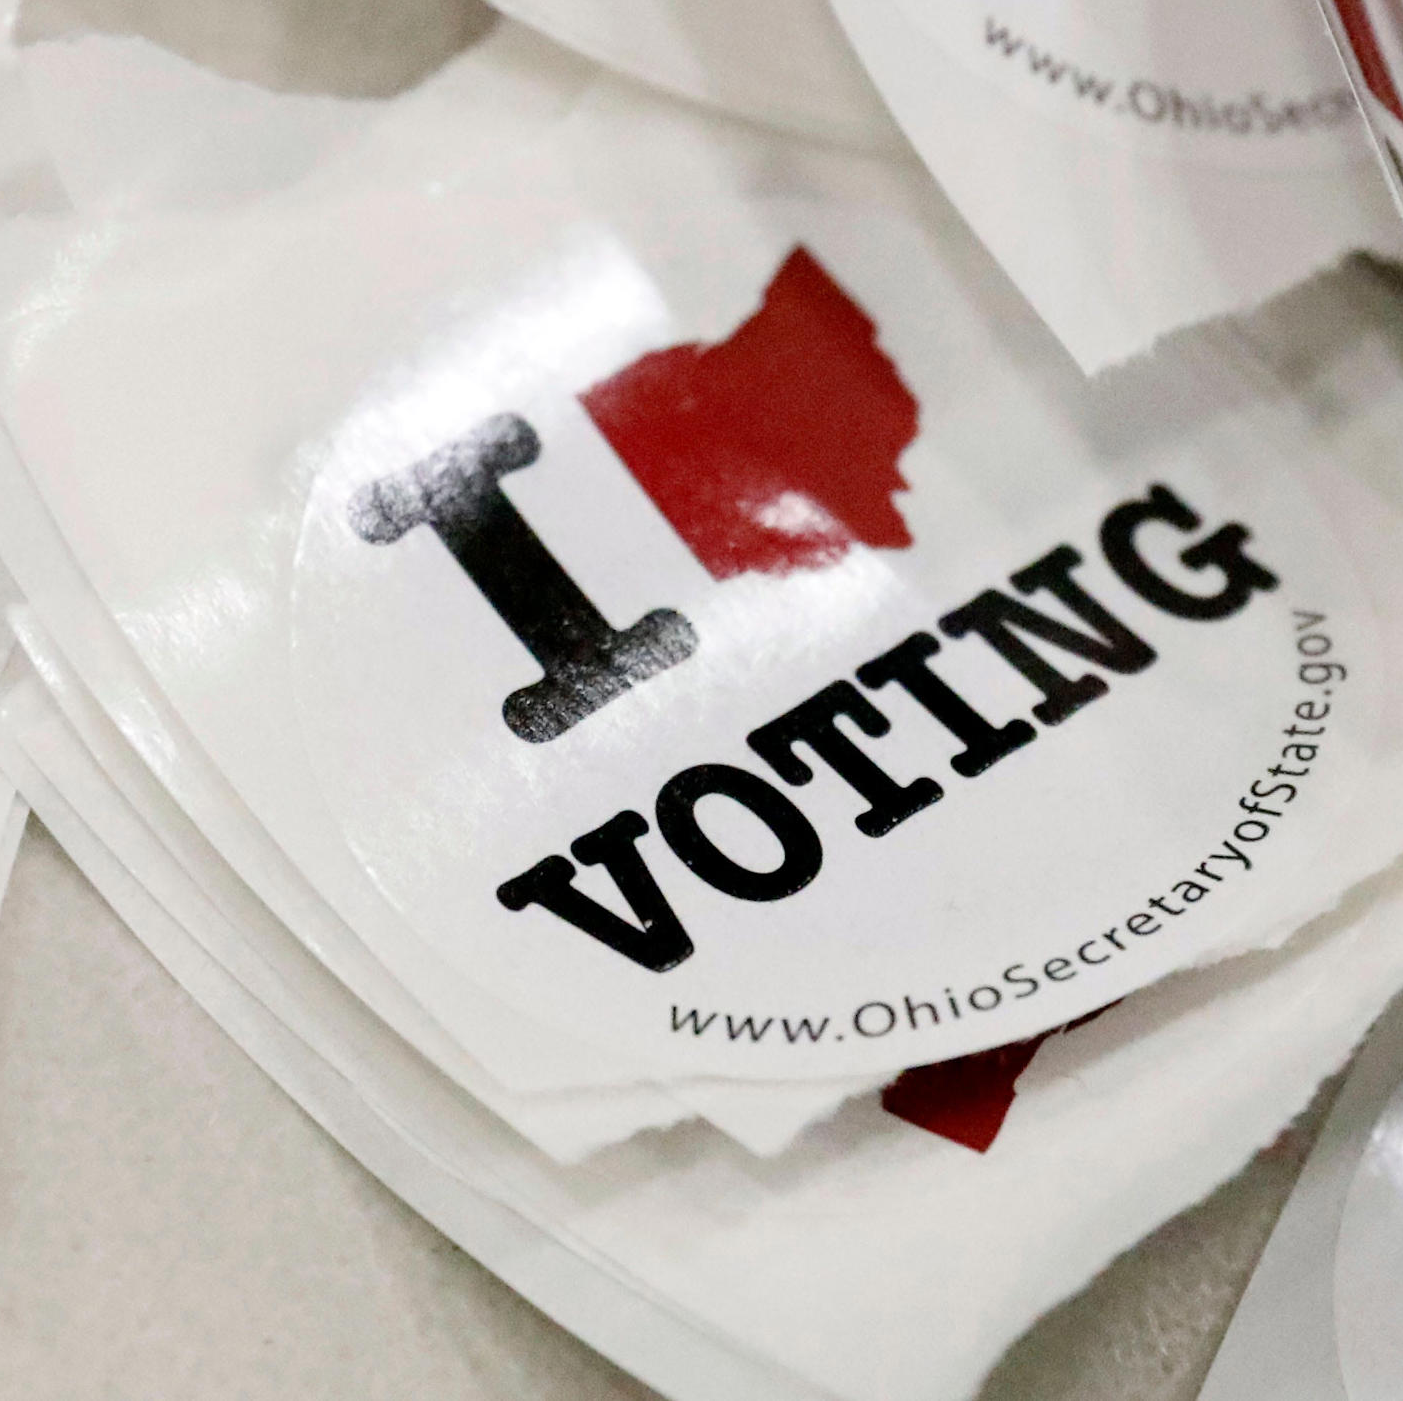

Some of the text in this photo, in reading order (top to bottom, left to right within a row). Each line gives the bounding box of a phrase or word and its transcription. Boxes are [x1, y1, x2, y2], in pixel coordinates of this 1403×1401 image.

[347, 410, 701, 745] I
[496, 483, 1281, 974] VOTING
[670, 607, 1349, 1046] www.OhioSecretaryofState.gov
